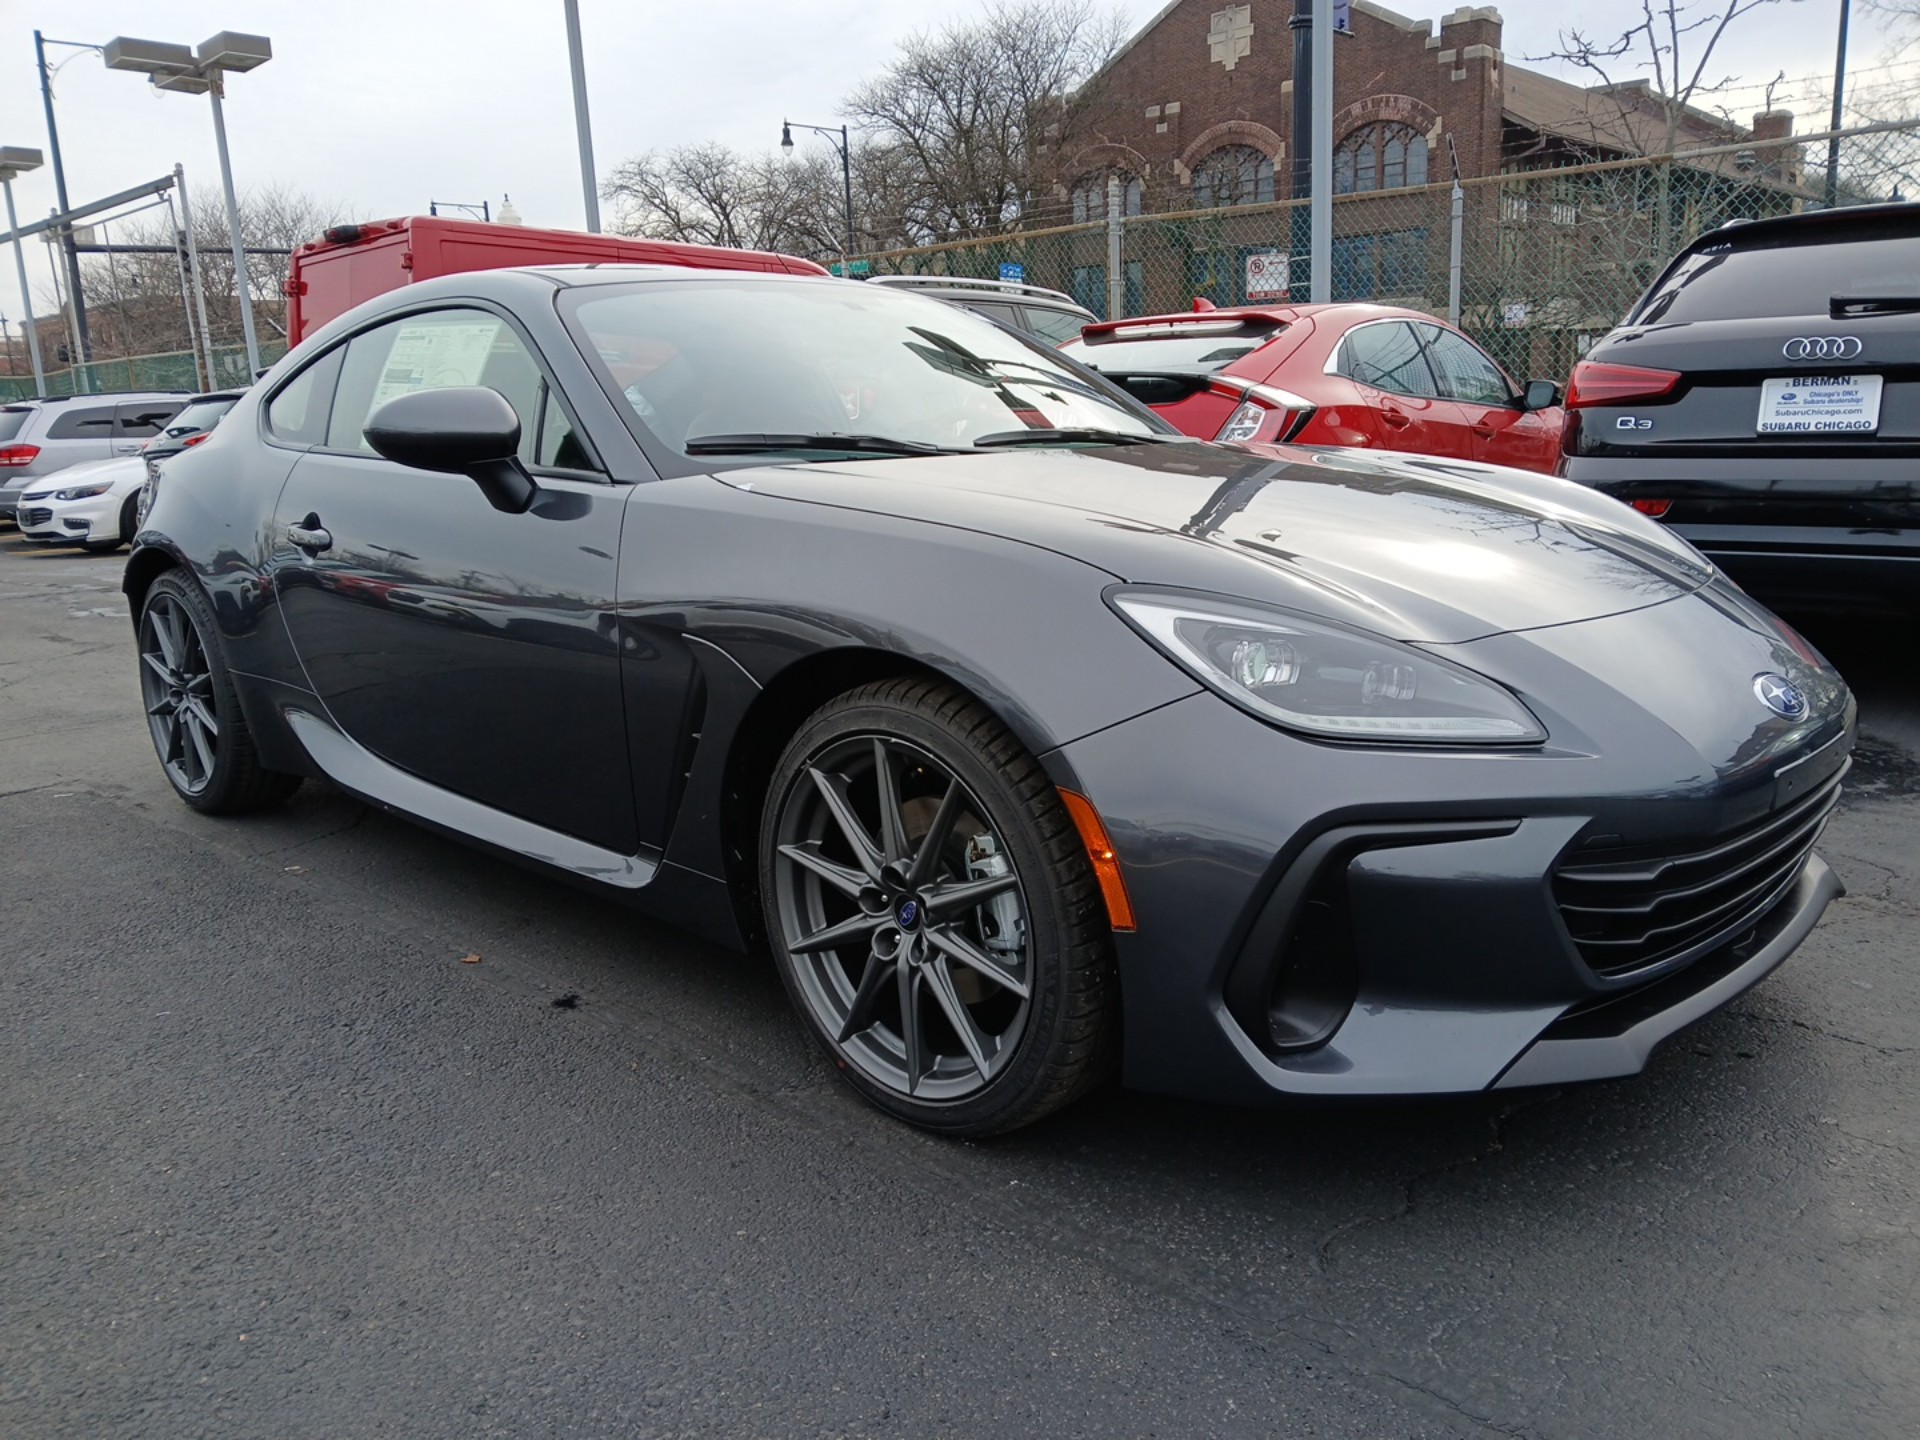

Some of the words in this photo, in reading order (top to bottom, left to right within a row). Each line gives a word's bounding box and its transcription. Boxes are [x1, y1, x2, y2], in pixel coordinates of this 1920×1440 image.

[1792, 376, 1851, 387] BERMAN
[1775, 408, 1863, 416] SubaruChicago.com
[1616, 416, 1653, 429] Q3
[1761, 422, 1811, 431] SUBARU
[1815, 420, 1872, 430] CHICAGO
